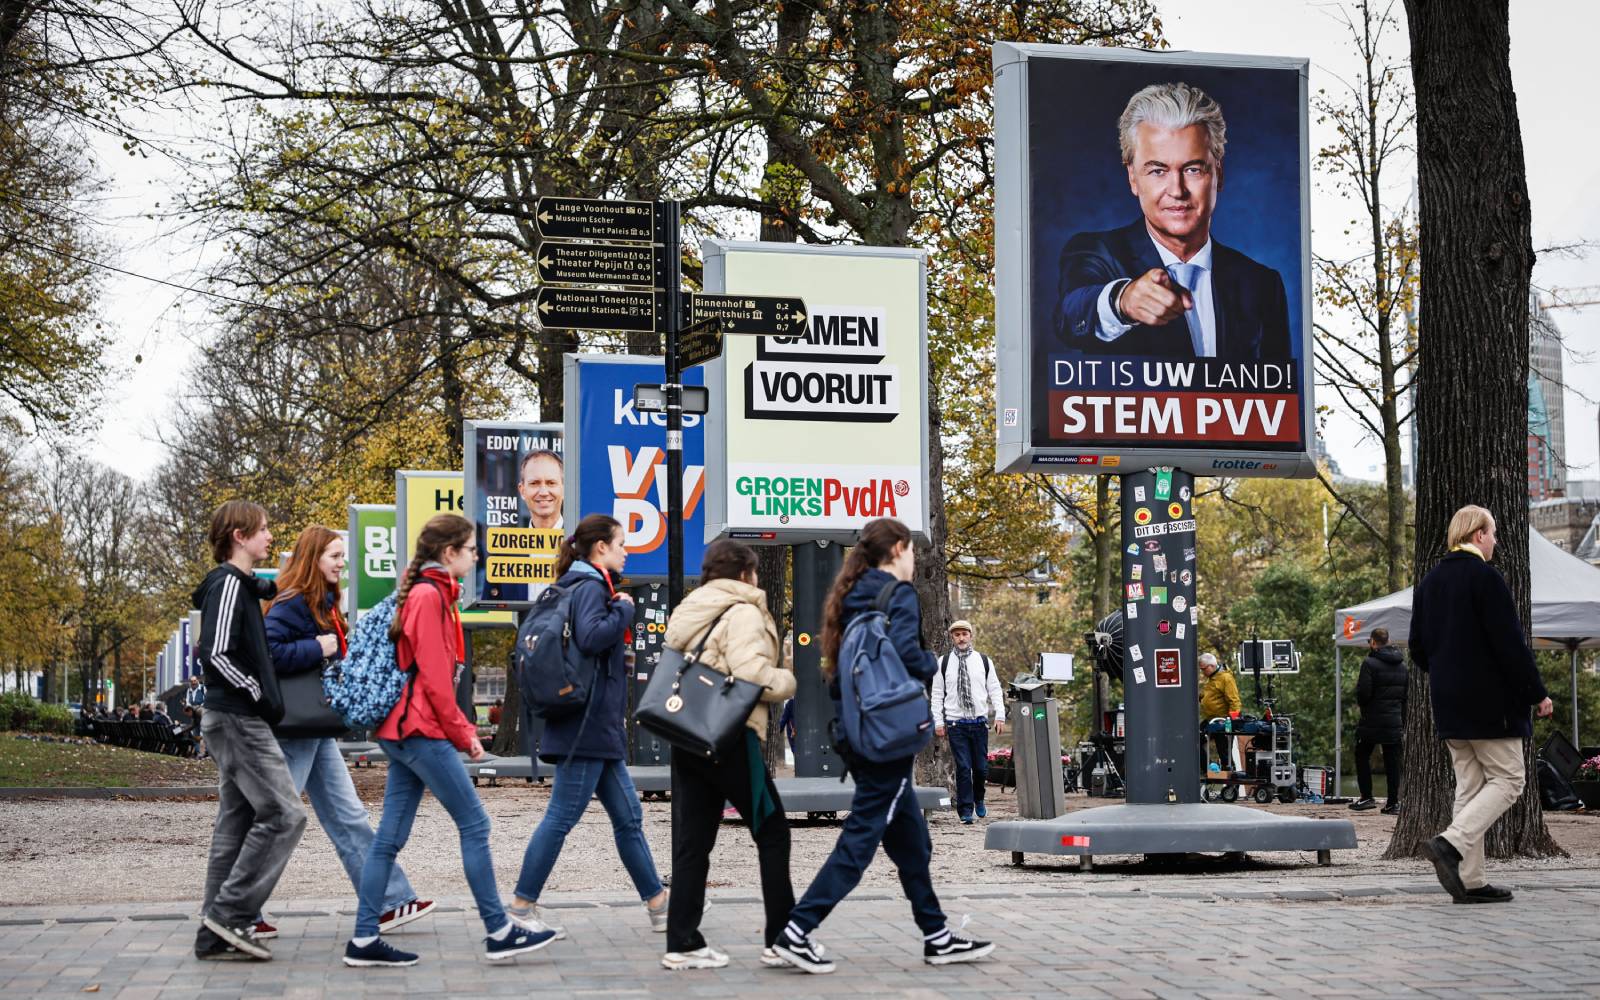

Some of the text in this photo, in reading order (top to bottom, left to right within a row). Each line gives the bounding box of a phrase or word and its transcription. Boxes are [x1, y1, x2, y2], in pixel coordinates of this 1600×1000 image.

[555, 203, 650, 215] Lange Voorhout 0,2
[555, 214, 615, 224] Museum Escher
[592, 226, 605, 234] het
[606, 227, 629, 235] Paleis
[556, 248, 587, 257] Theater
[589, 249, 628, 260] Diligentia
[556, 258, 651, 271] Theater Pepijn 0,9
[556, 270, 587, 278] Museum
[588, 271, 631, 280] Meermanno
[556, 294, 598, 303] Nationaal
[600, 295, 629, 304] Toneel
[695, 298, 789, 311] Binnenhof 0,2
[556, 304, 652, 316] Centraal Station 1,2
[695, 308, 789, 321] Mauritshuis 0,4
[773, 315, 879, 347] AMEN
[776, 323, 789, 332] 0,7
[1054, 360, 1293, 389] DIT IS UW LAND!
[759, 371, 893, 405] VOORUIT
[614, 388, 701, 428] ks
[1062, 395, 1287, 436] STEM PVV
[486, 435, 565, 452] EDDY VAN H
[735, 476, 823, 497] GROEN
[486, 496, 518, 510] STEM
[824, 479, 897, 517] PvdA
[751, 497, 823, 517] LINKS
[1136, 526, 1150, 536] DIT
[1152, 524, 1161, 534] IS
[364, 525, 397, 554] B
[491, 533, 545, 549] ZORGEN
